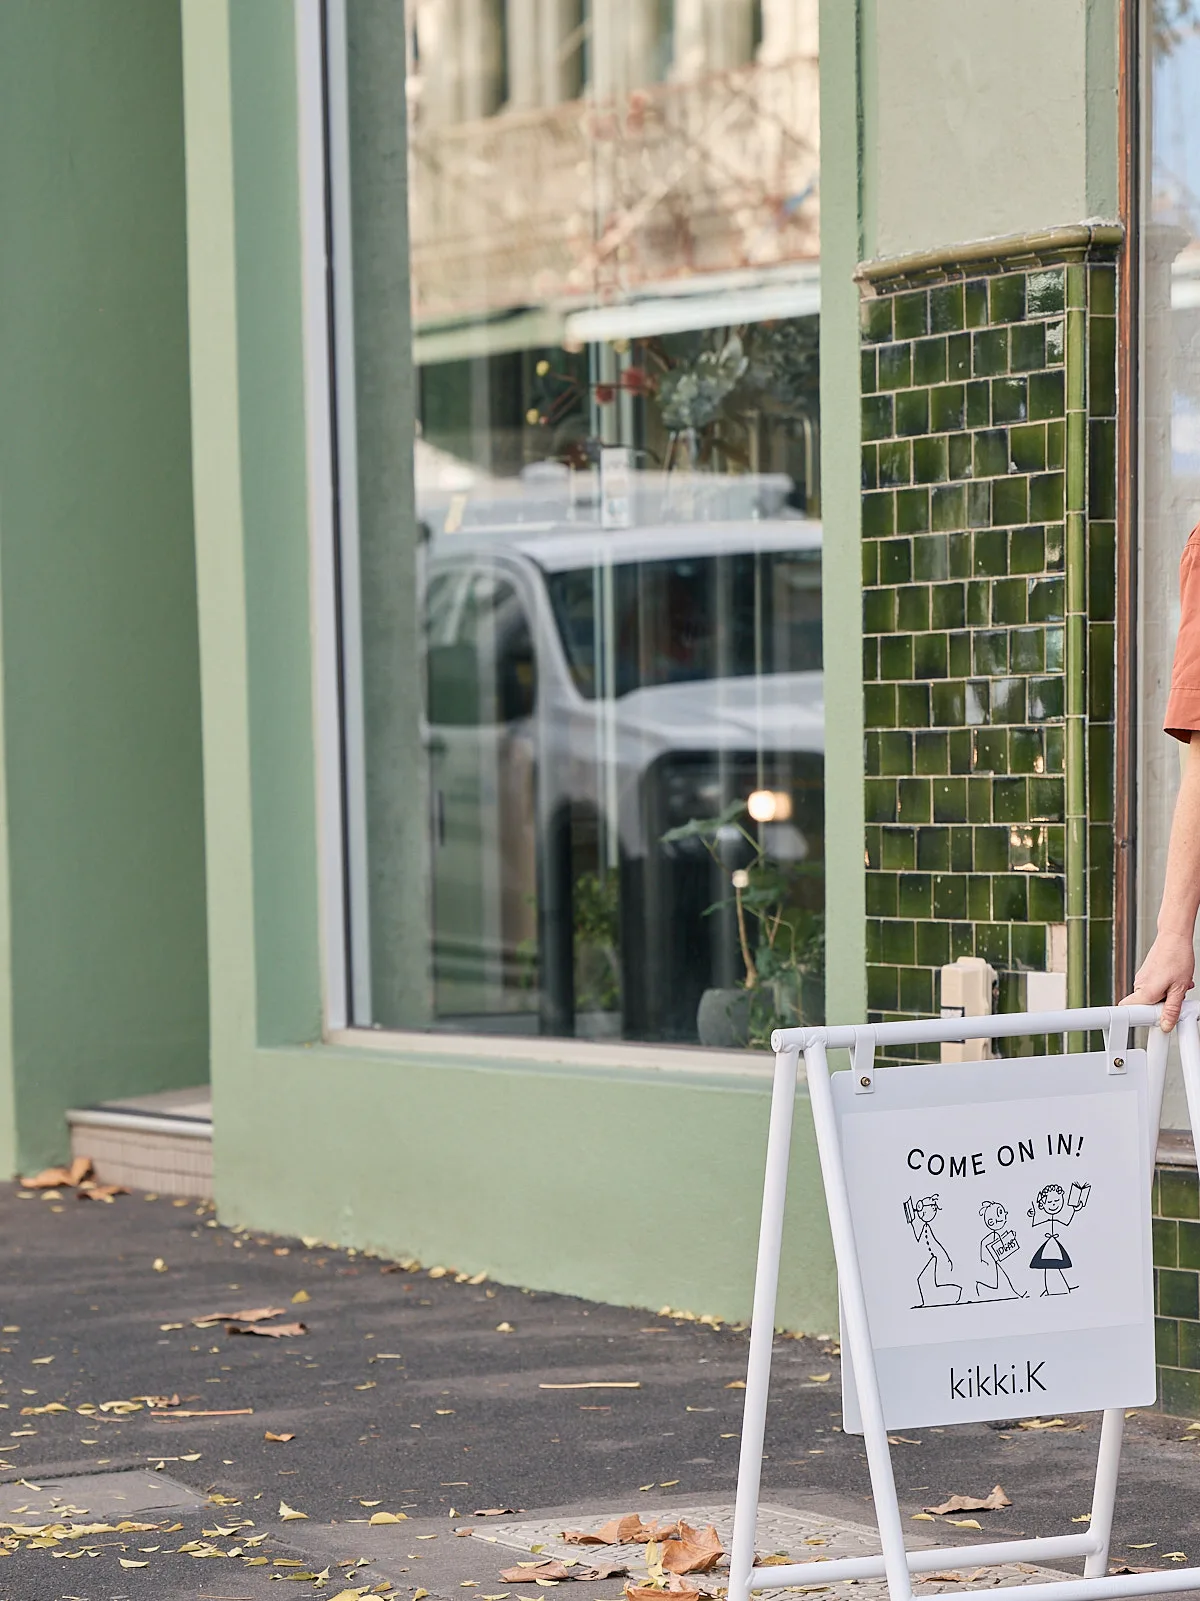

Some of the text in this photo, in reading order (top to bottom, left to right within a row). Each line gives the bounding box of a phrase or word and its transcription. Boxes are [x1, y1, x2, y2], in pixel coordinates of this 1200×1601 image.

[907, 1133, 1084, 1177] COME ON IN!
[950, 1361, 1047, 1399] kikki.K
